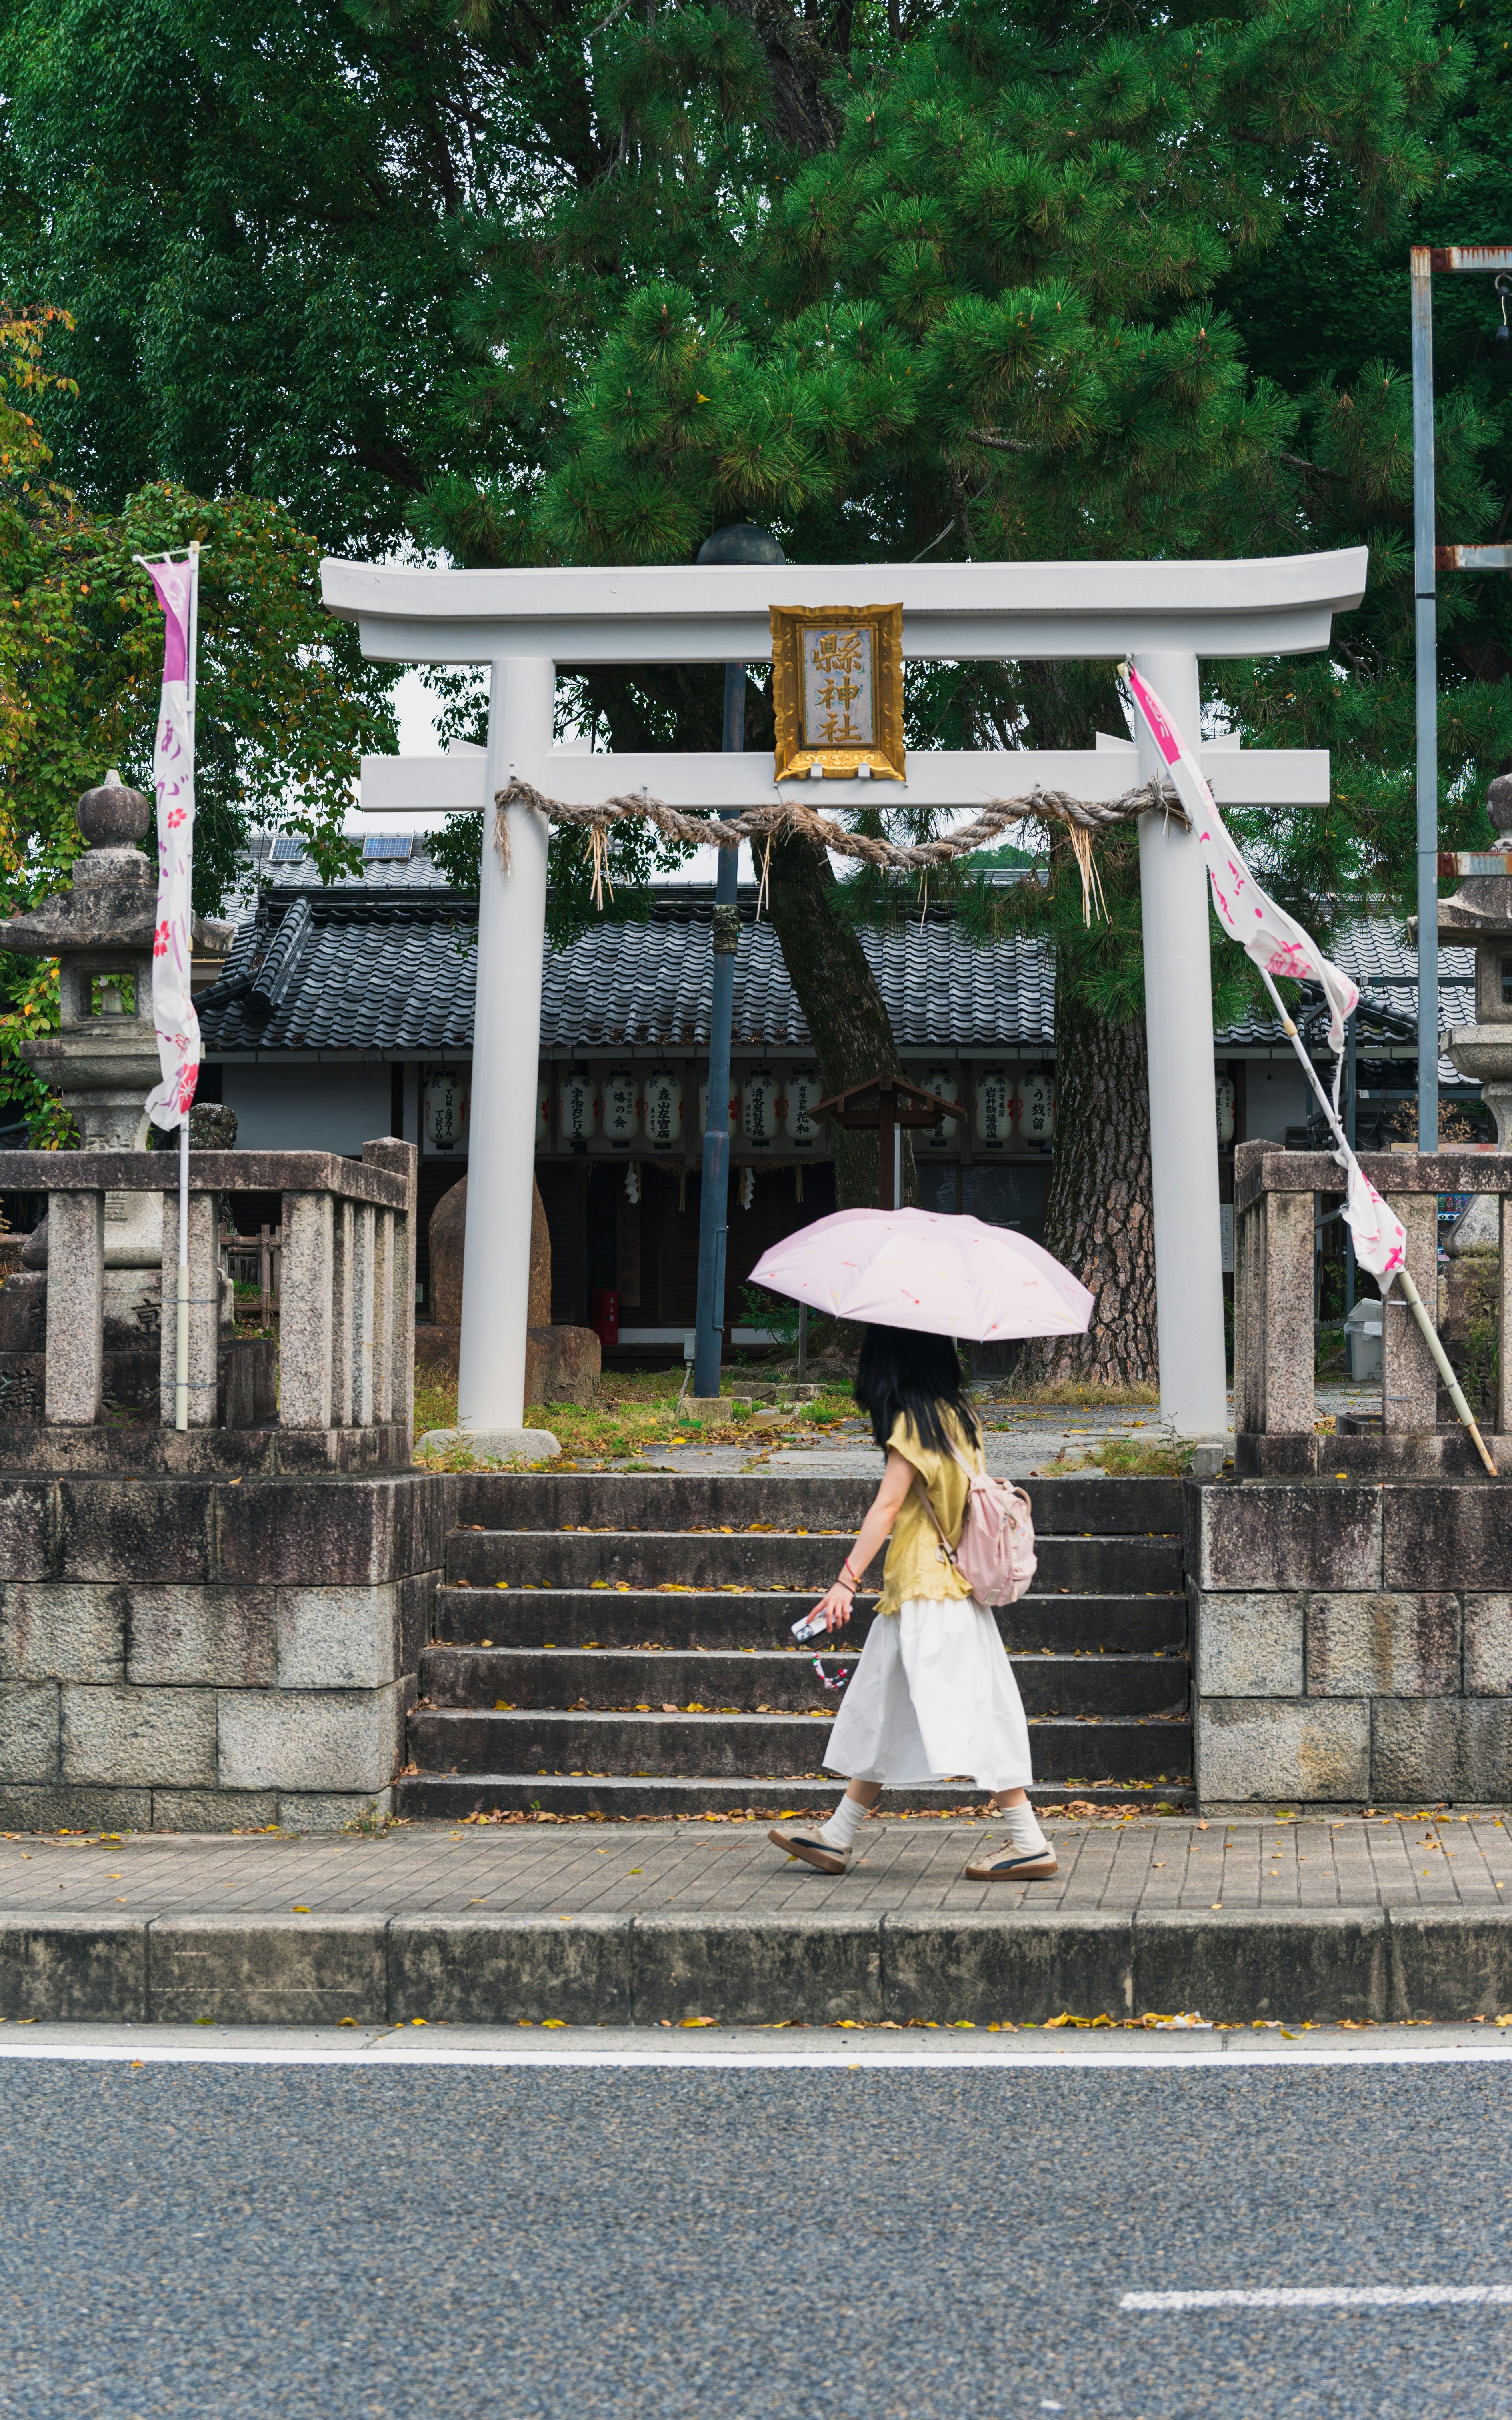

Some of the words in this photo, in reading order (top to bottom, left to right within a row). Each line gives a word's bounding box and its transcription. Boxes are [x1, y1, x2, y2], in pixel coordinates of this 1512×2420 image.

[813, 631, 862, 743] 縣神社
[445, 1089, 453, 1106] THE
[436, 1110, 444, 1138] TOKYO
[445, 1108, 453, 1136] AGATA
[656, 1087, 672, 1139] 森山左官店
